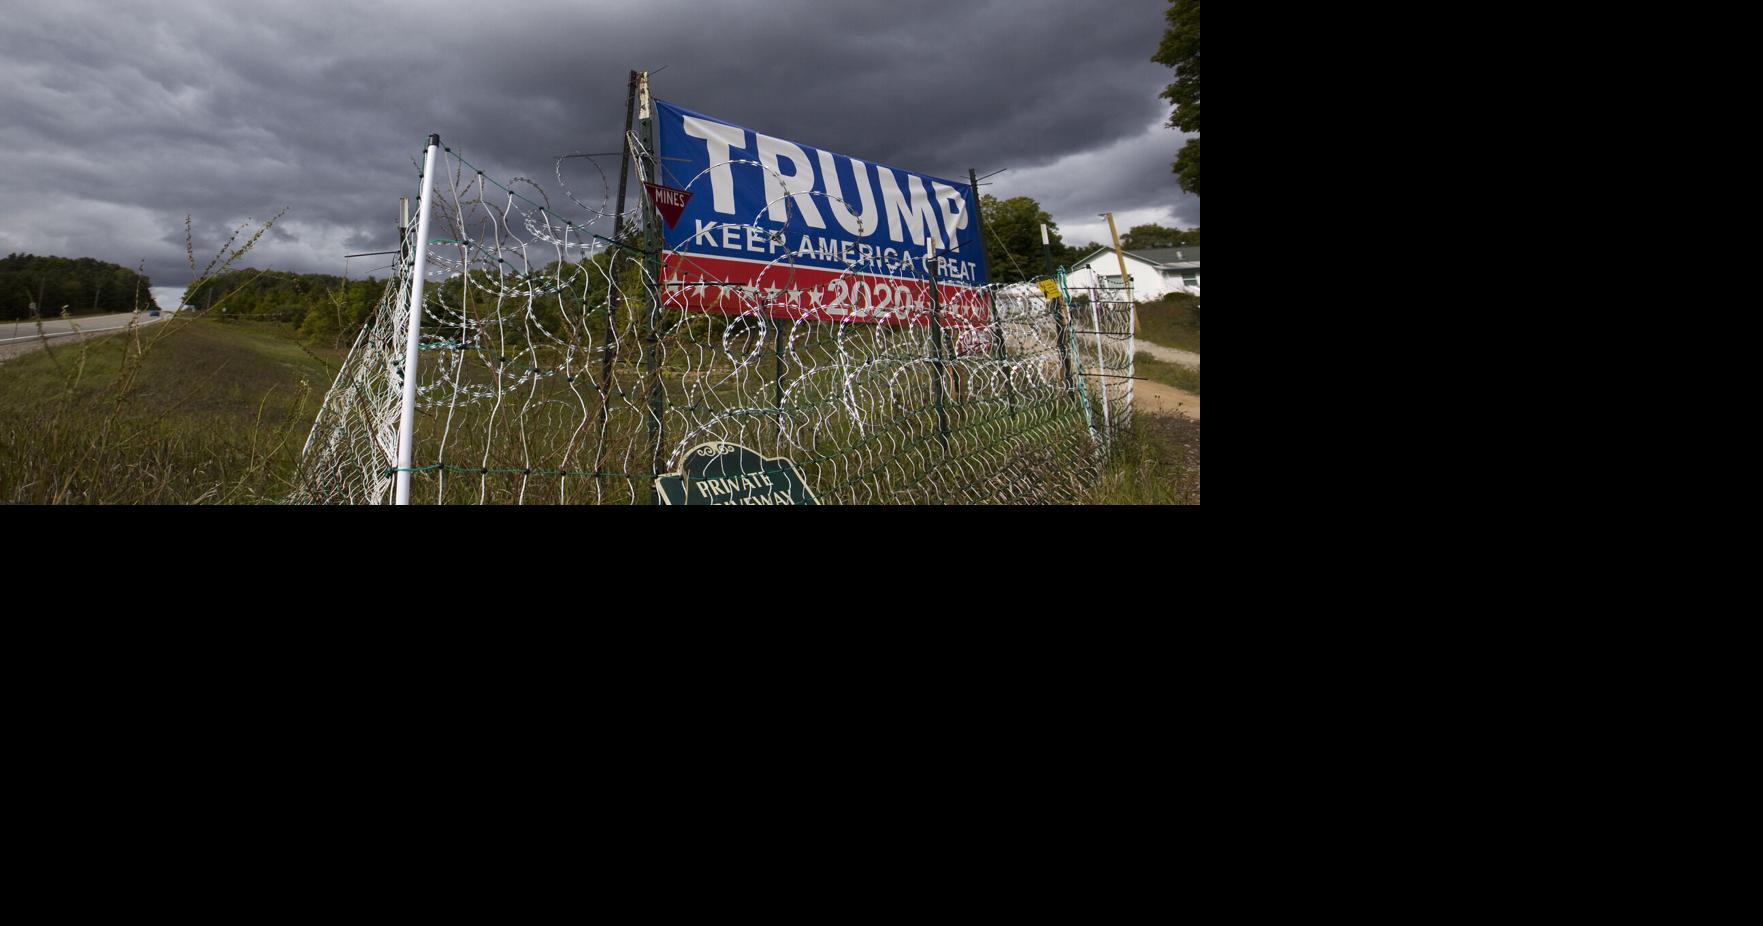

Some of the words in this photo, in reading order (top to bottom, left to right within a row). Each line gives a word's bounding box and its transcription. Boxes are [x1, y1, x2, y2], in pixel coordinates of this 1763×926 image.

[655, 188, 685, 207] MINES
[682, 115, 969, 253] TRUMP
[695, 219, 786, 255] KEEP
[798, 235, 913, 271] AMERICA
[826, 278, 913, 320] 2020
[696, 471, 774, 498] PRIVATE
